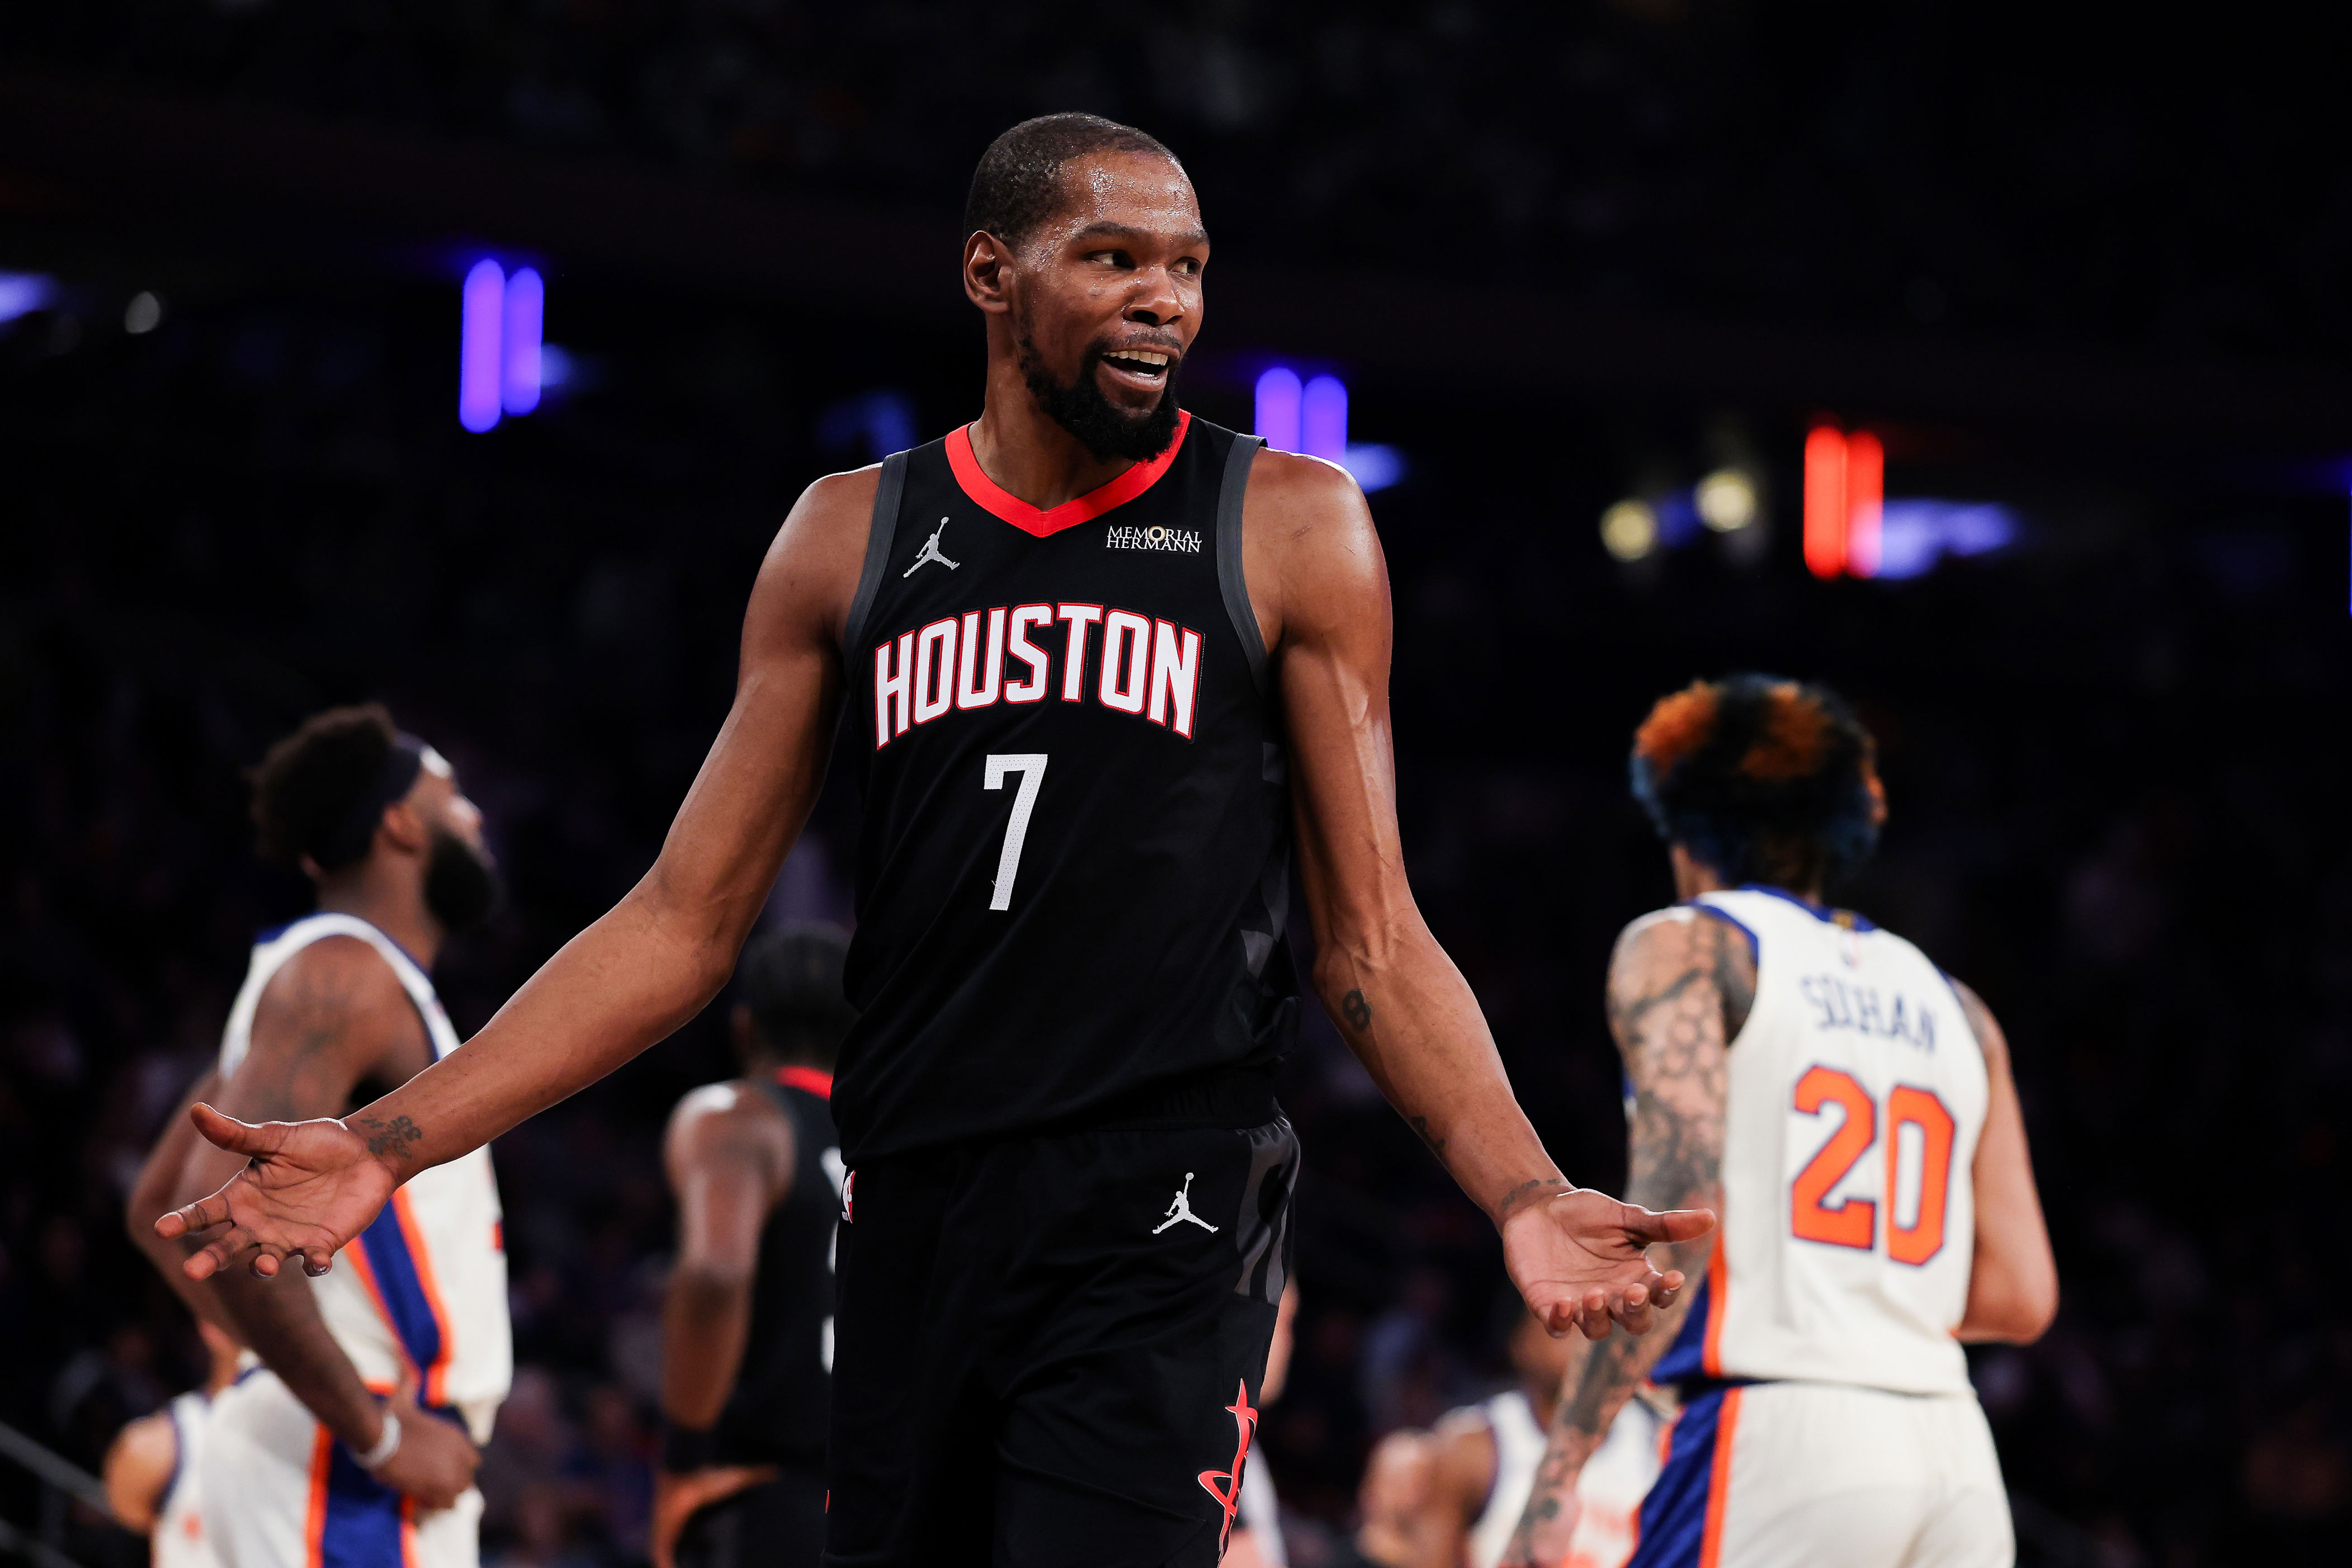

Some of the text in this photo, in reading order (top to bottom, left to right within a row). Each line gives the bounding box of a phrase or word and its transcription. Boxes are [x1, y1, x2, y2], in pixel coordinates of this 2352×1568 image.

[1106, 536, 1201, 553] HERMANN
[1107, 525, 1202, 543] MEMORIAL
[875, 602, 1202, 750] HOUSTON
[983, 753, 1049, 911] 7
[1791, 1064, 1956, 1267] 20
